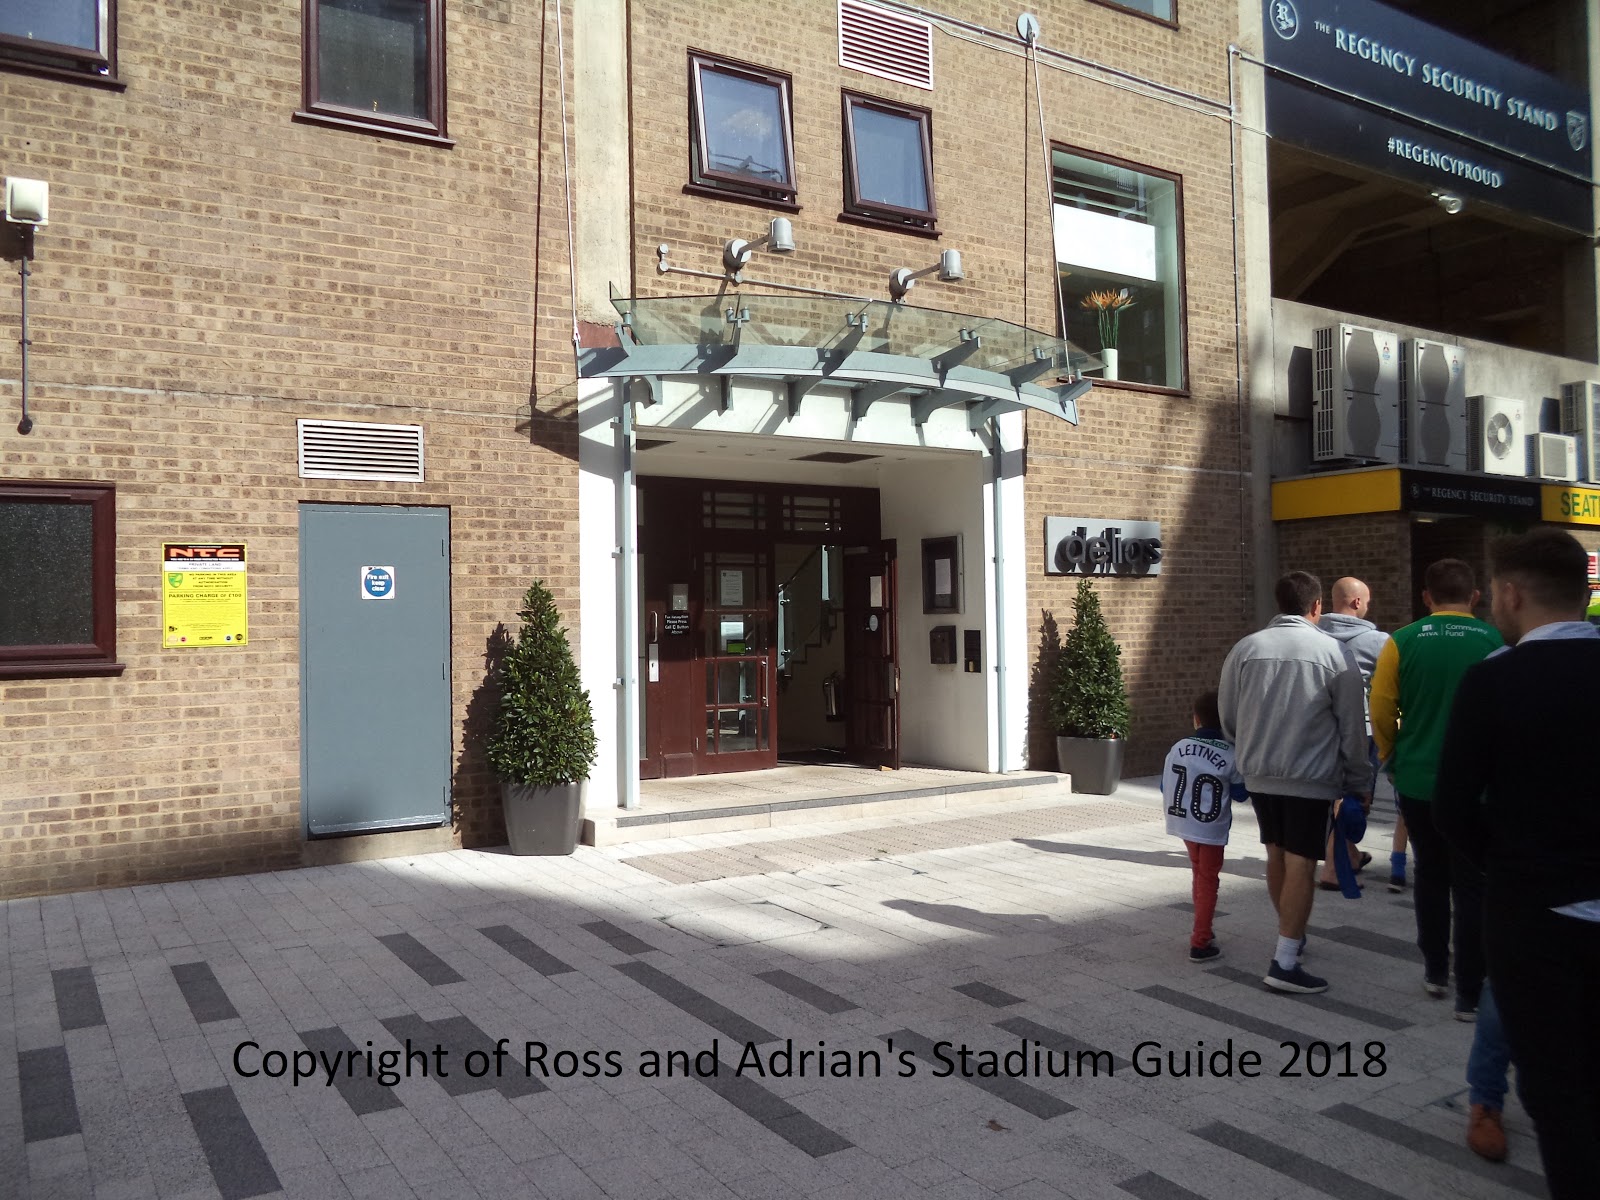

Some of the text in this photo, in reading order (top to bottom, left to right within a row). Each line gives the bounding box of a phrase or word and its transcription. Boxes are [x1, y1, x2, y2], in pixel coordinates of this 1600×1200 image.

[1314, 21, 1558, 132] THE REGENCY SECURITY STAND
[1387, 137, 1502, 189] #REGENCYPROUD
[1431, 487, 1467, 500] REGENCY
[1470, 490, 1506, 504] SECURITY
[1508, 495, 1535, 507] STAND
[170, 548, 240, 557] NTC
[1064, 526, 1163, 565] delias
[1445, 623, 1488, 635] Community
[1178, 744, 1227, 771] LEITNER
[1167, 763, 1224, 823] 10
